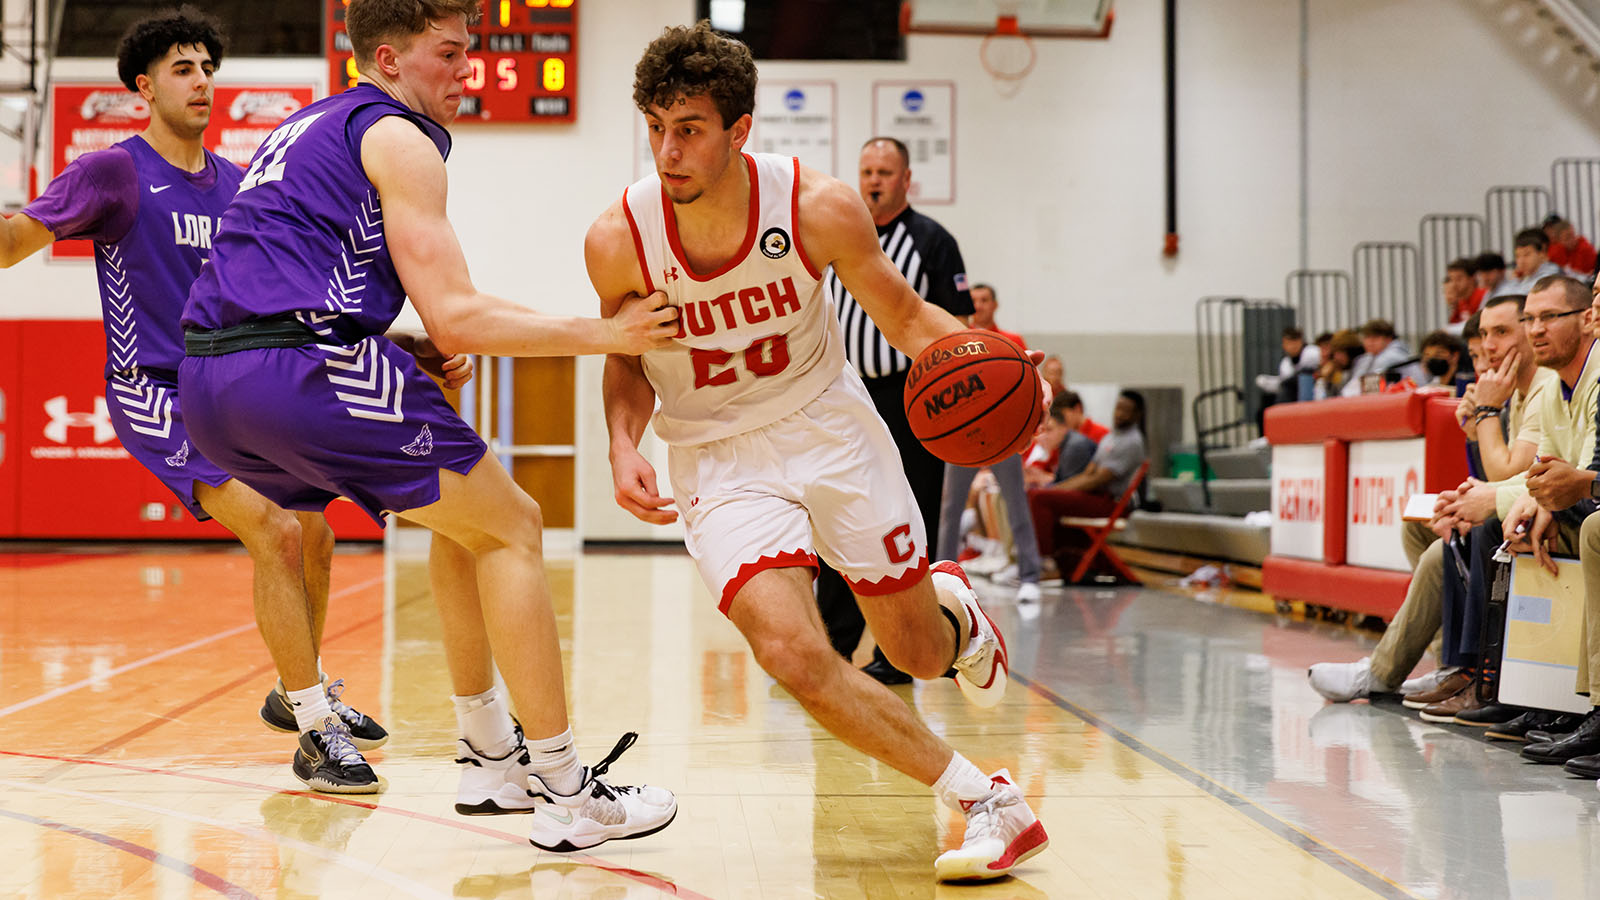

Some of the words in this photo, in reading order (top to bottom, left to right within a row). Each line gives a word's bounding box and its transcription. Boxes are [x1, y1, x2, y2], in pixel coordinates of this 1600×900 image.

[496, 57, 518, 91] 5
[542, 57, 565, 92] 8
[171, 211, 222, 250] LOR
[690, 333, 792, 390] 20
[907, 341, 990, 391] Wilson
[923, 373, 986, 420] NCAA
[1278, 478, 1322, 523] CENTRA
[881, 522, 915, 566] C
